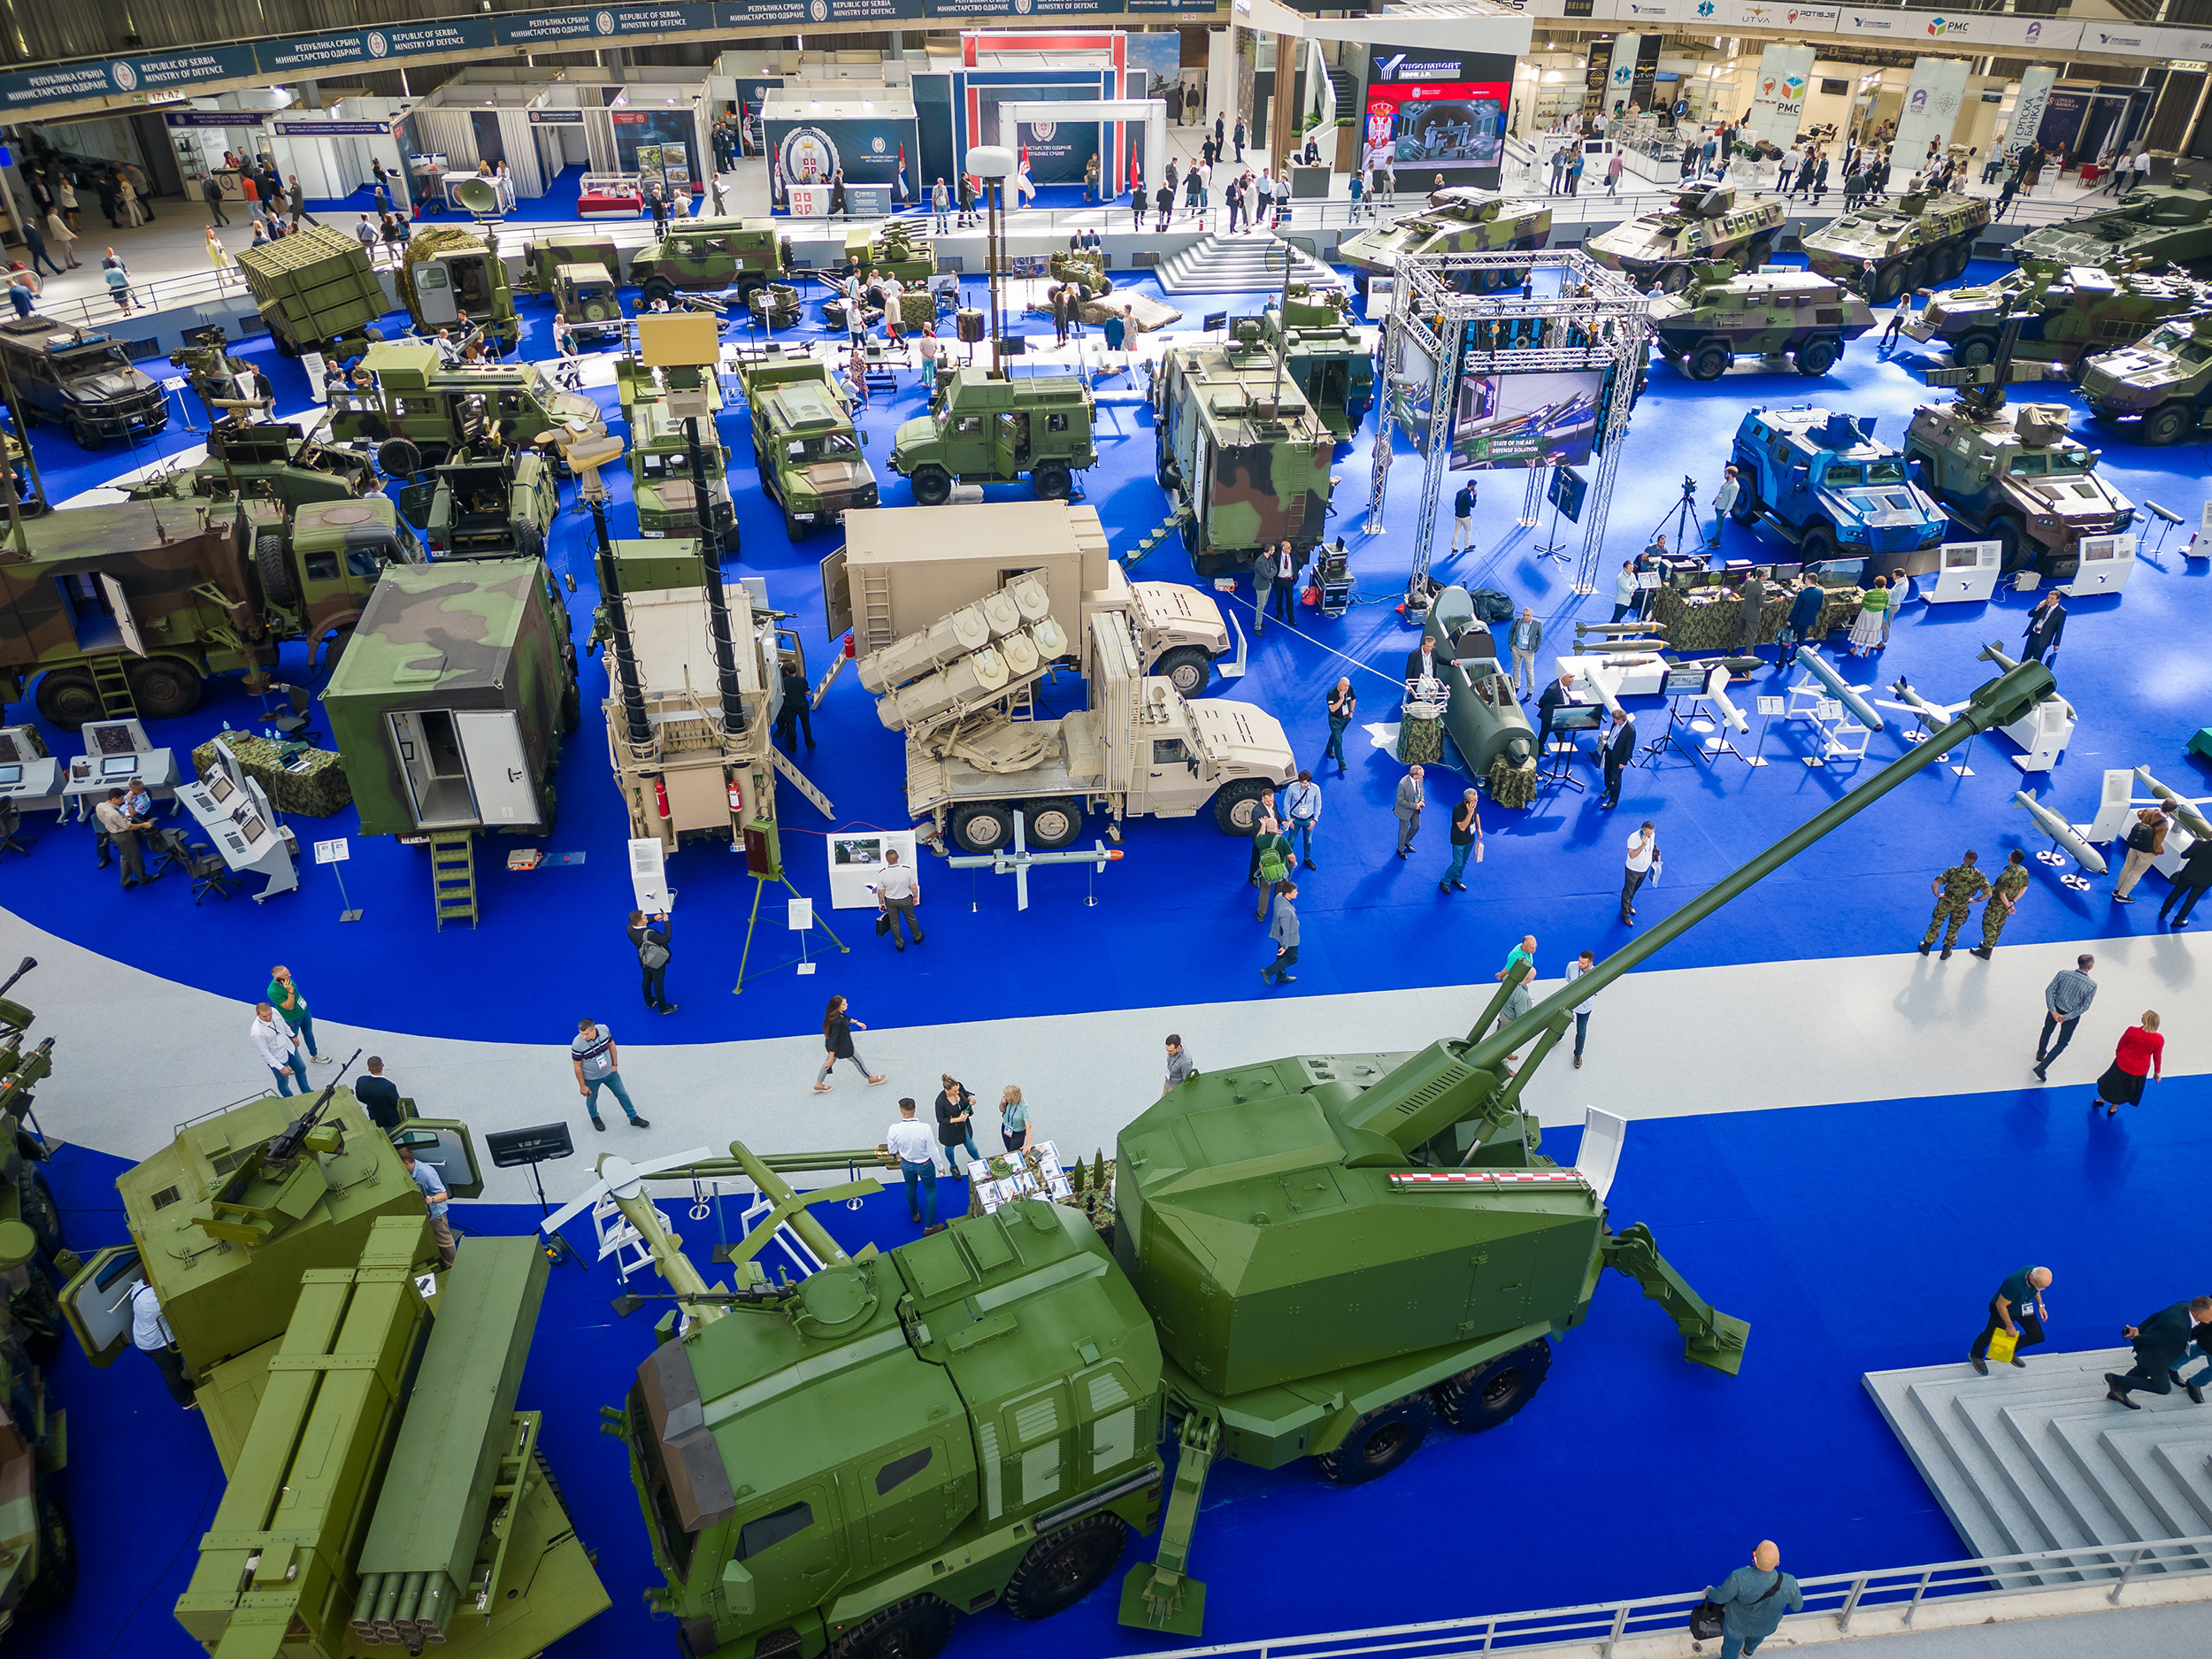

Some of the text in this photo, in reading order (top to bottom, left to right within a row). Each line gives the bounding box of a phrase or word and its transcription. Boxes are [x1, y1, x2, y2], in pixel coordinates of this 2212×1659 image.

[529, 15, 590, 27] РЕПУБЛИКА СРБИЈА
[619, 12, 649, 21] REPUBLIC
[659, 10, 681, 19] SERBIA
[730, 11, 805, 22] МИНИСТАРСТВО ОДБРАНЕ
[621, 20, 650, 30] MINISTRY
[660, 18, 687, 27] DEFENCE
[1947, 22, 1970, 31] PMC
[392, 27, 458, 42] REPUBLIC OF SERBIA
[511, 25, 590, 38] МИНИСТАРСТВО ОДБРАНЕ
[295, 38, 361, 53] РЕПУБЛИКА СРБИЈА
[395, 36, 465, 50] MINISTRY OF DEFENCE
[275, 47, 362, 65] МИНИСТАРСТВО ОДБРАНЕ
[141, 56, 216, 73] REPUBLIC OF SERBIA
[28, 68, 106, 88] РЕПУБЛИКА СРБИЈА
[144, 65, 225, 83] MINISTRY OF DEFENCE
[7, 80, 109, 102] МИНИСТАРСТВО ОДБРАНЕ
[151, 89, 181, 102] IZLAZ
[1777, 103, 1801, 113] PMC
[2015, 97, 2035, 135] СРПСКА
[2024, 102, 2042, 136] БАНКА
